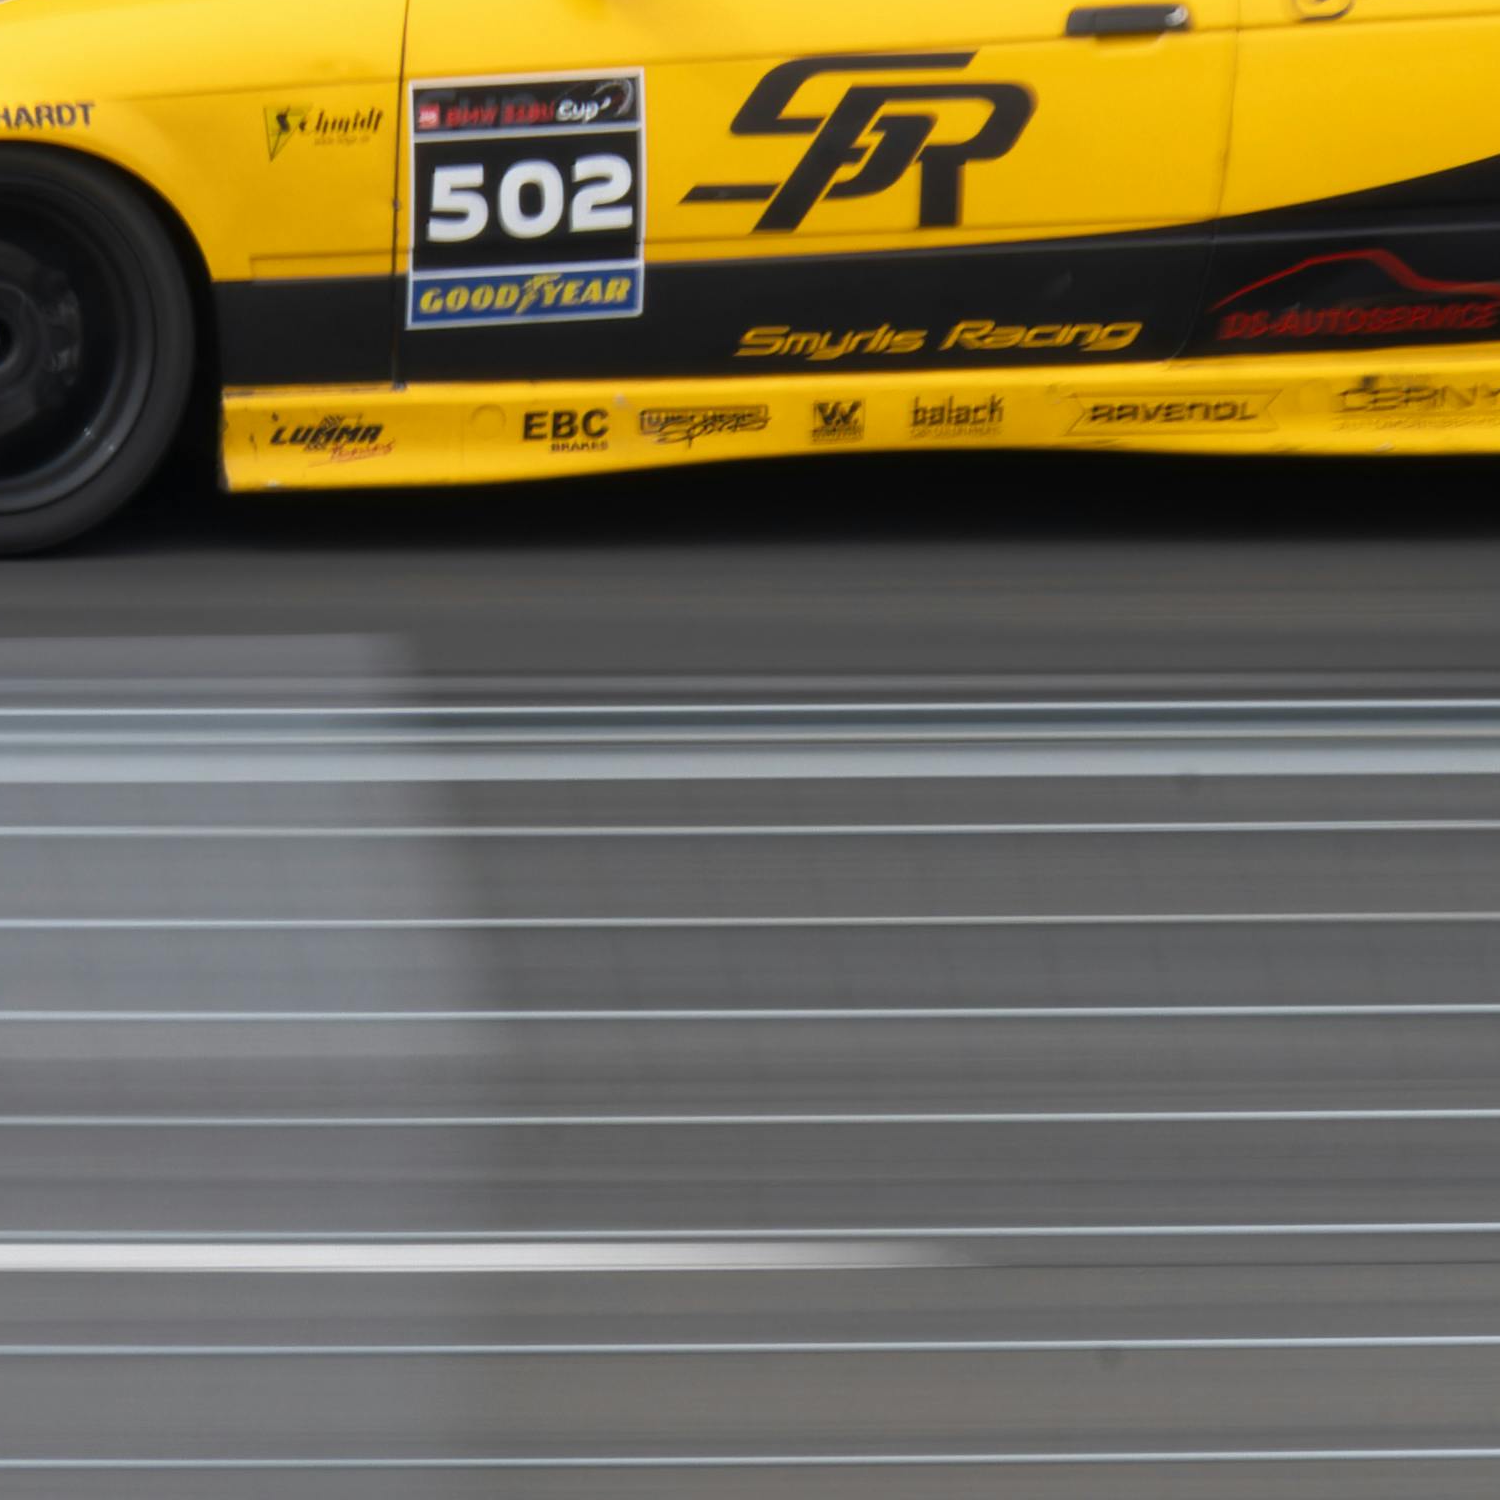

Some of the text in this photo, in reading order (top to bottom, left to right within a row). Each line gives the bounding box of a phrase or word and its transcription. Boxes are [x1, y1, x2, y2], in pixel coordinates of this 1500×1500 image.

[426, 153, 634, 242] 502
[419, 273, 632, 316] GOODYEAR
[733, 320, 1143, 361] Smyrlis Racing
[523, 408, 608, 441] EBC
[1089, 399, 1258, 423] RAVENOL
